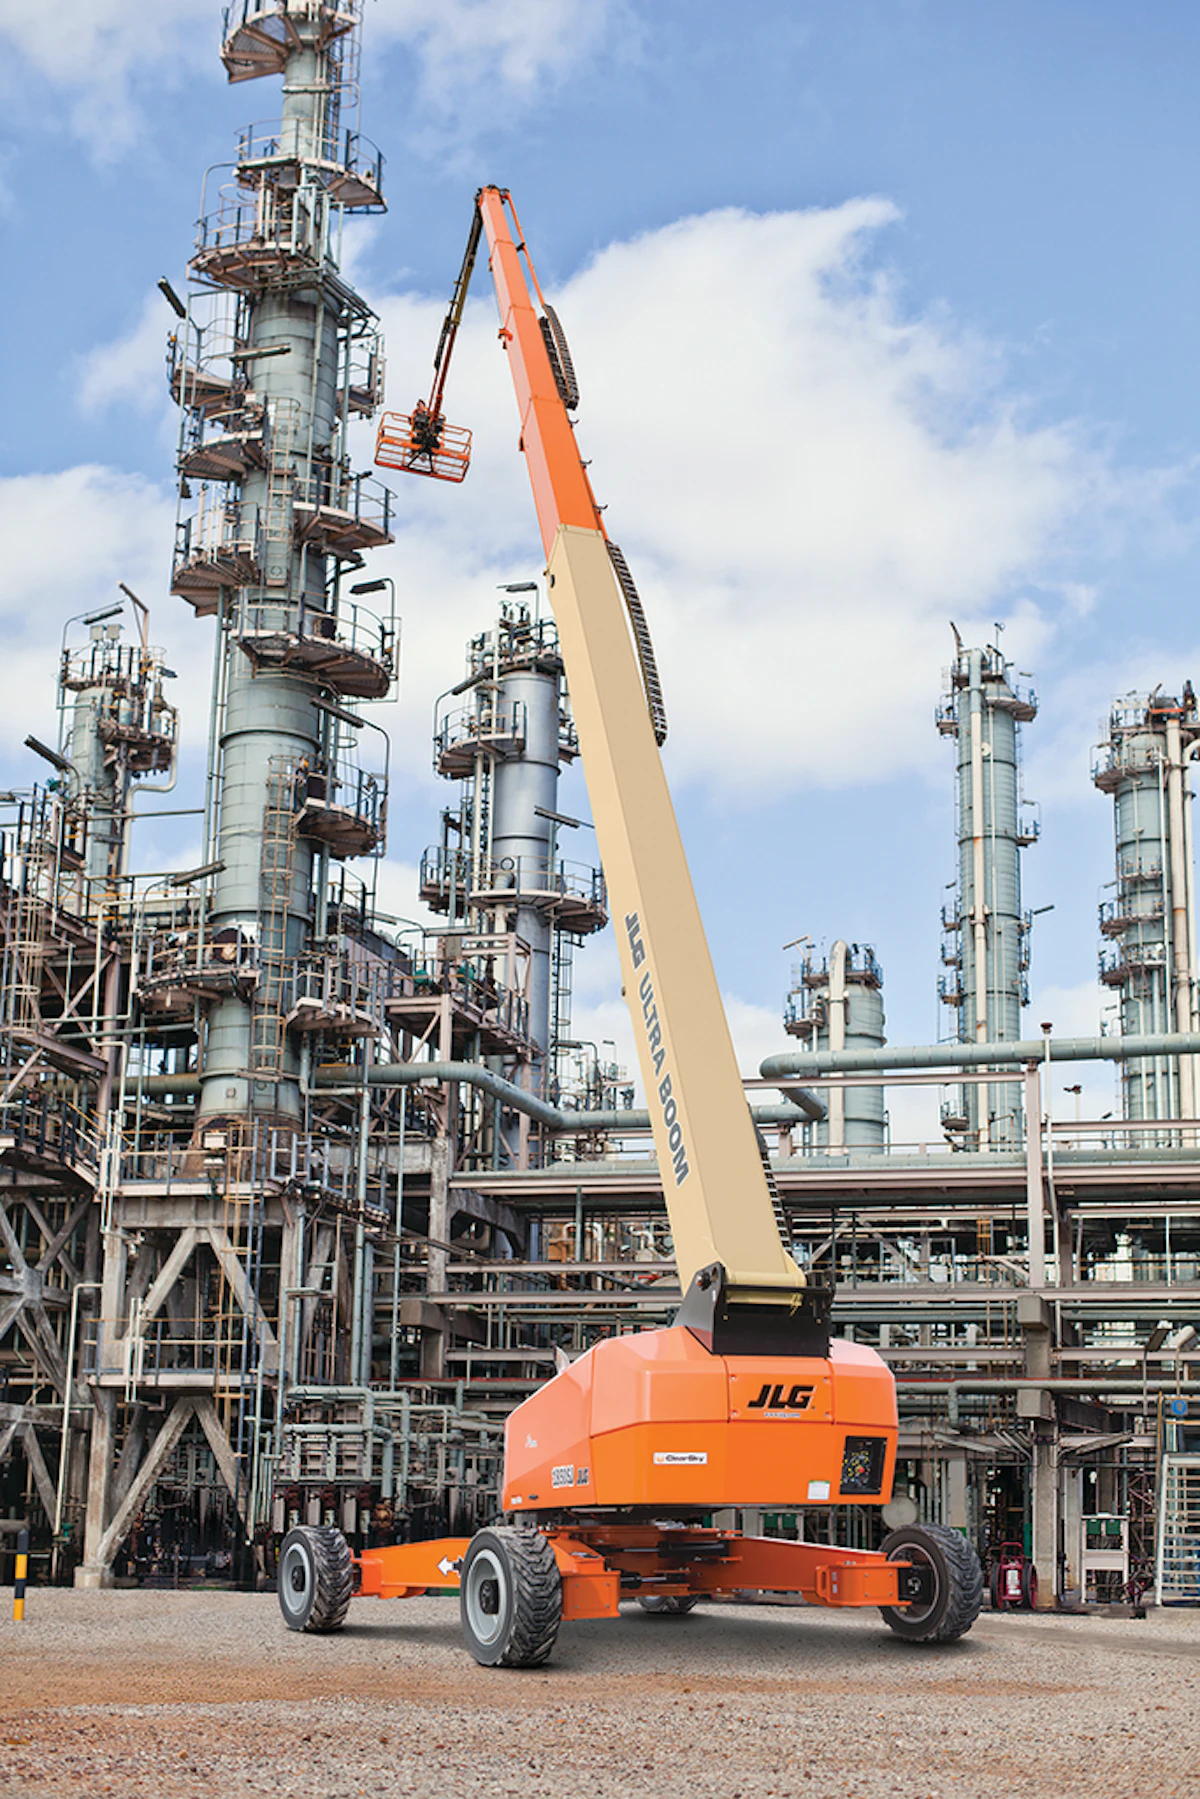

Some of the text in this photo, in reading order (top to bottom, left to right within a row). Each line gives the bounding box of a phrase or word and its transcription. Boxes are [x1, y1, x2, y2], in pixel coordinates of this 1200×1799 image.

[625, 911, 689, 1186] JLG ULTRA BOOM
[747, 1384, 815, 1408] JLG
[666, 1454, 704, 1462] ClearSky
